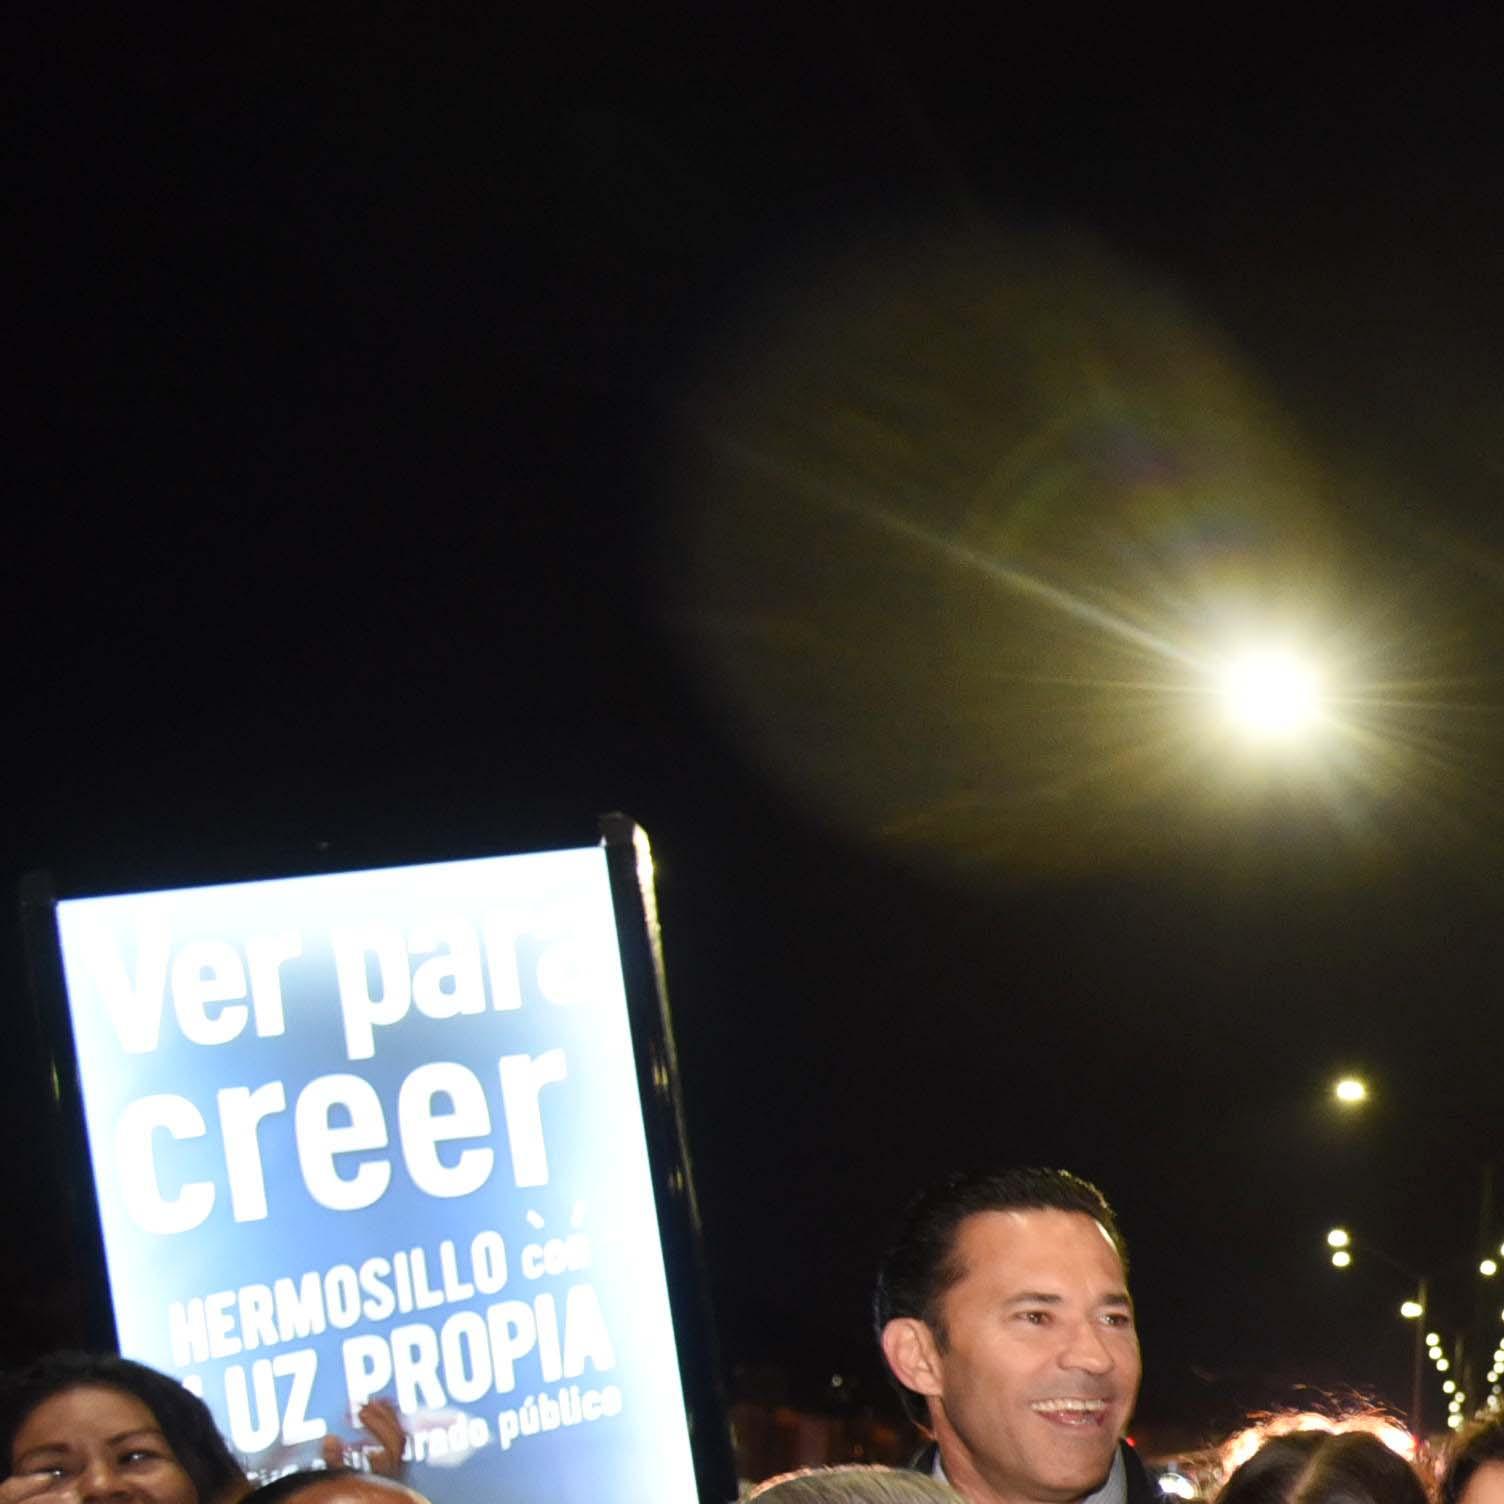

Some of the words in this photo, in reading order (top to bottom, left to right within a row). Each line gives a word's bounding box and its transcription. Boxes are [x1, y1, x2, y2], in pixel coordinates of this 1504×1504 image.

[84, 906, 302, 1055] Ver
[115, 1048, 569, 1237] creer
[169, 1229, 508, 1367] HERMOSILLO
[343, 1284, 619, 1428] PROPIA
